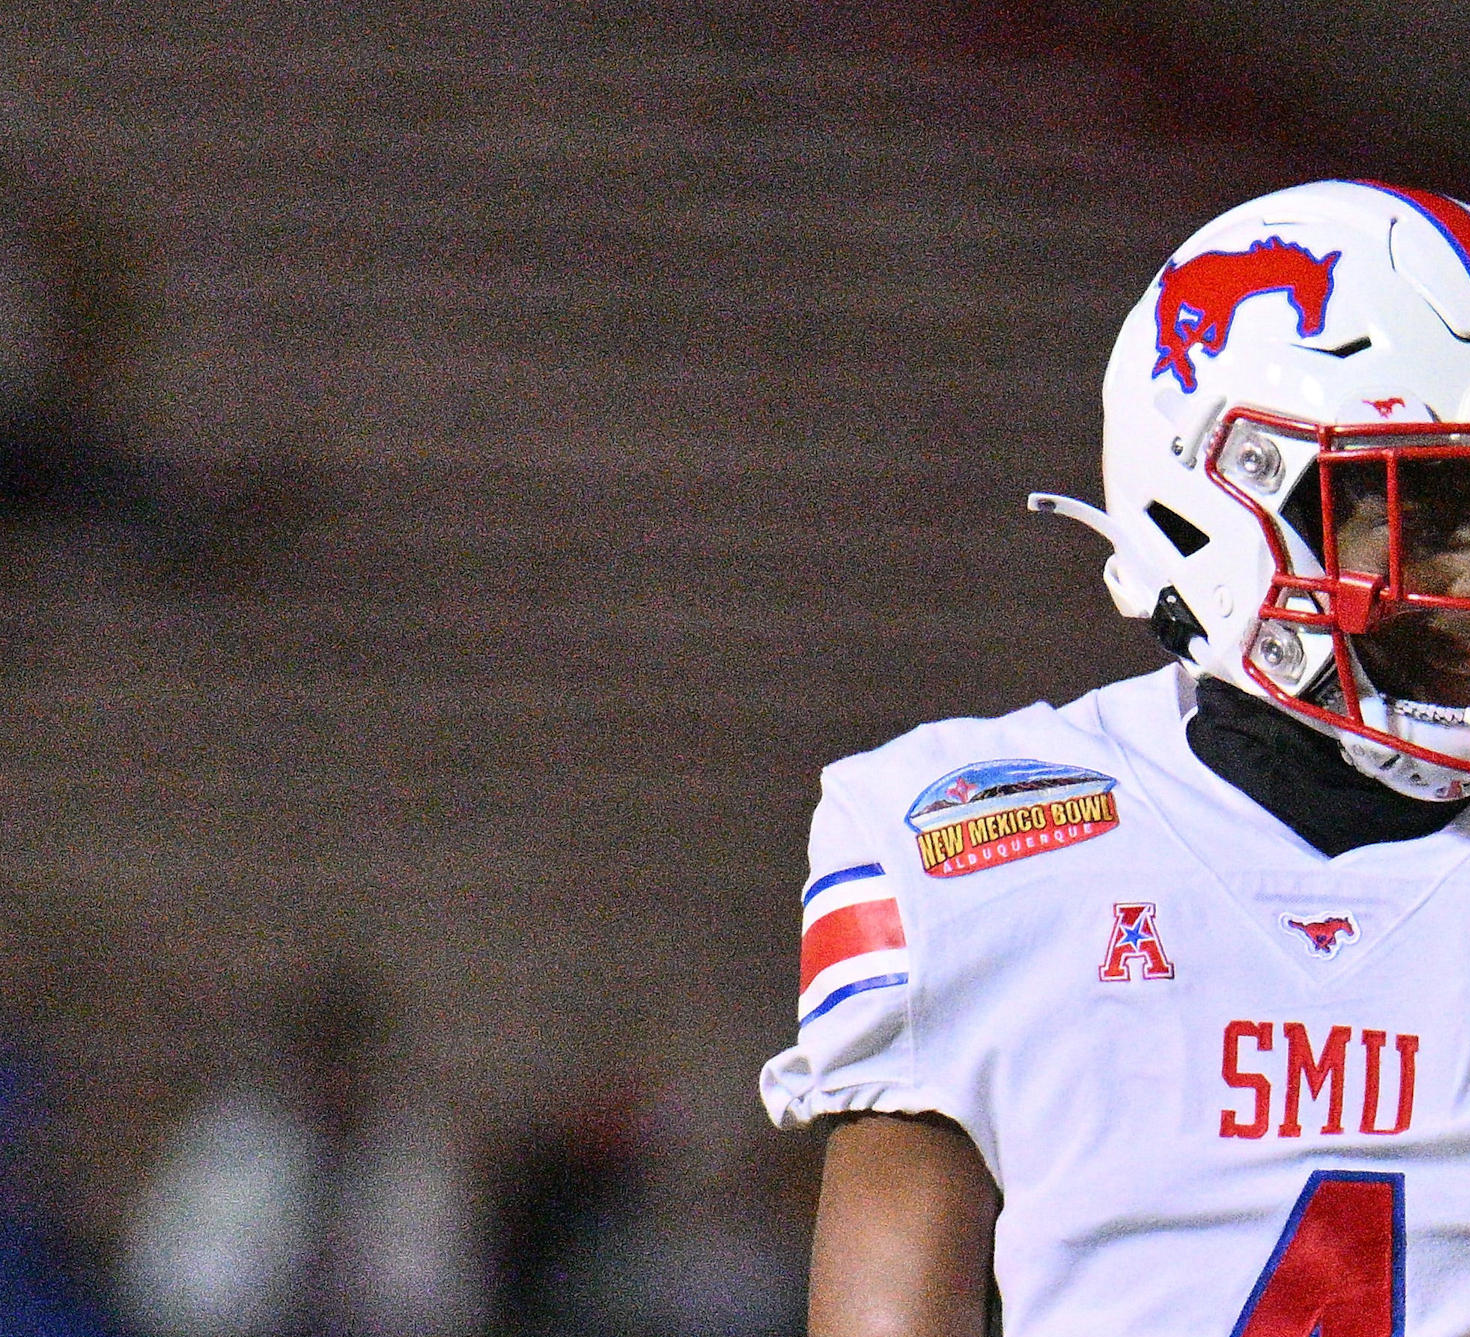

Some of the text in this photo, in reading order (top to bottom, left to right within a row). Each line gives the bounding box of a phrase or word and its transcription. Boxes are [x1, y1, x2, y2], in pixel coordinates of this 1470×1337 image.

[918, 794, 1114, 870] NEW MEXICO BOWL
[943, 823, 1093, 874] ALBUQUERQUE
[1220, 1020, 1419, 1139] SMU
